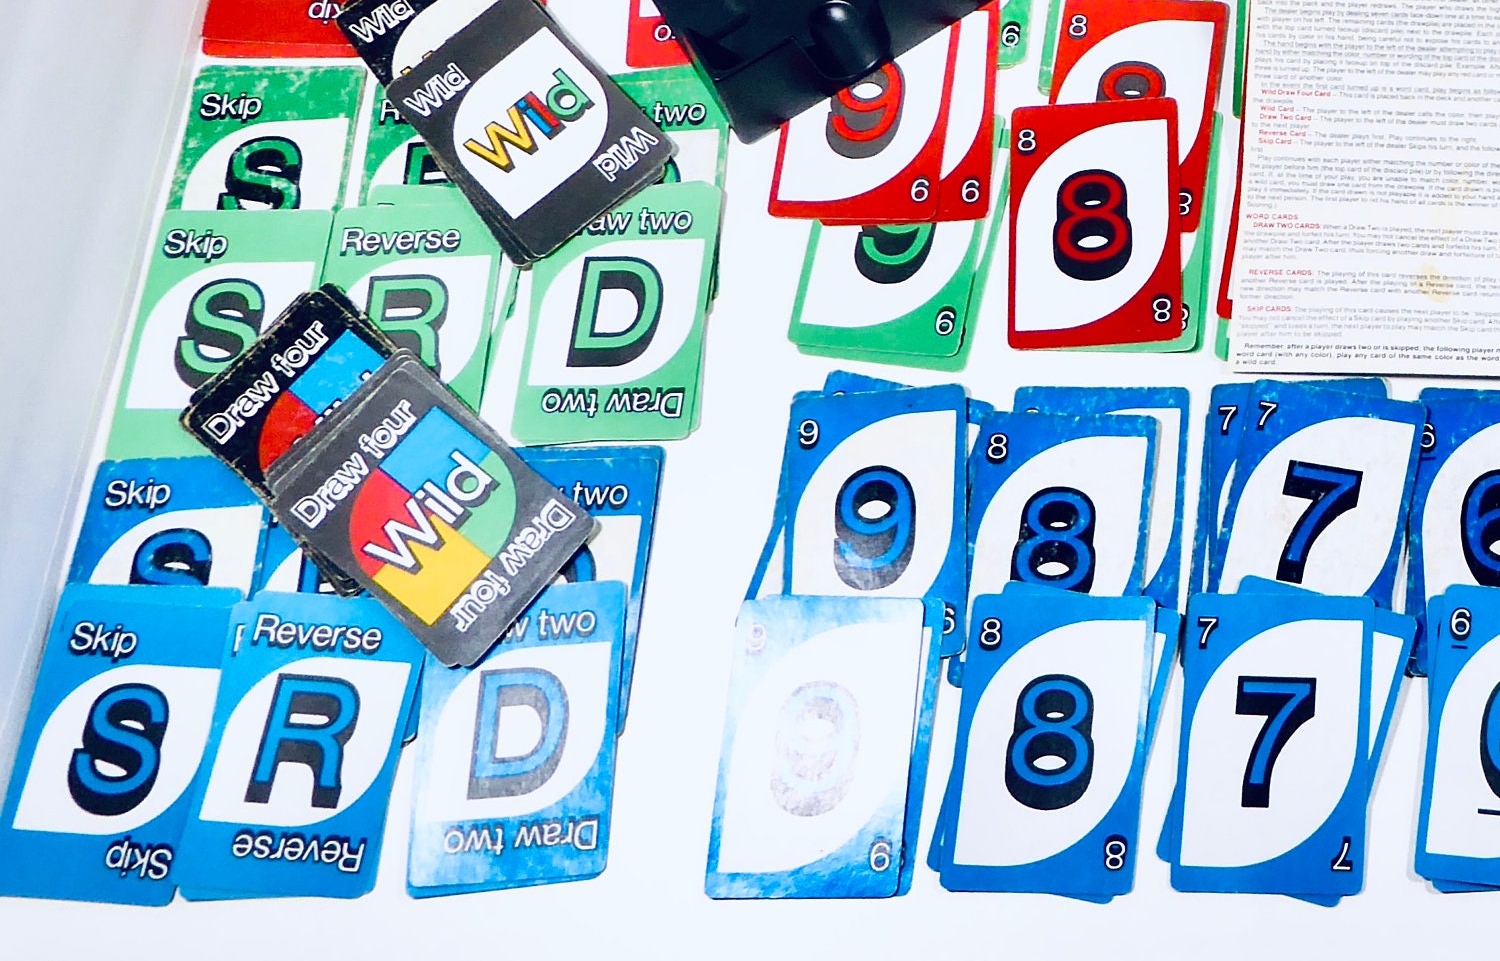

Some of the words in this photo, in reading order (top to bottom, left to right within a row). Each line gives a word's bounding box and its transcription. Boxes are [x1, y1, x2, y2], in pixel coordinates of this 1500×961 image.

[199, 94, 261, 121] Skip
[402, 63, 470, 117] Wild
[654, 102, 706, 126] two
[463, 68, 591, 173] Wild
[592, 127, 659, 182] Wild
[163, 229, 227, 258] Skip
[340, 228, 460, 253] Reverse
[639, 208, 692, 235] two
[1052, 168, 1132, 281] 8
[175, 278, 265, 389] S
[366, 274, 448, 374] R
[566, 256, 664, 368] D
[201, 371, 280, 444] Draw
[270, 320, 329, 377] four
[542, 389, 598, 415] two
[607, 392, 683, 417] Draw
[290, 453, 369, 528] Draw
[359, 399, 418, 458] four
[104, 480, 171, 509] Skip
[363, 450, 501, 576] Wild
[574, 481, 629, 508] two
[1276, 459, 1363, 584] 7
[500, 498, 576, 576] Draw
[833, 465, 916, 591] 9
[1010, 486, 1096, 593] 8
[450, 570, 511, 632] four
[538, 610, 596, 636] two
[1450, 607, 1472, 641] 6
[69, 622, 137, 656] Skip
[253, 614, 382, 651] Reverse
[1196, 617, 1217, 650] 7
[67, 683, 168, 816] S
[244, 672, 360, 808] R
[466, 668, 570, 801] D
[1005, 673, 1094, 810] 8
[1235, 675, 1317, 808] 7
[105, 835, 173, 878] Skip
[232, 830, 365, 873] Reverse
[444, 822, 506, 854] two
[514, 819, 597, 850] Draw
[1104, 833, 1127, 870] 8
